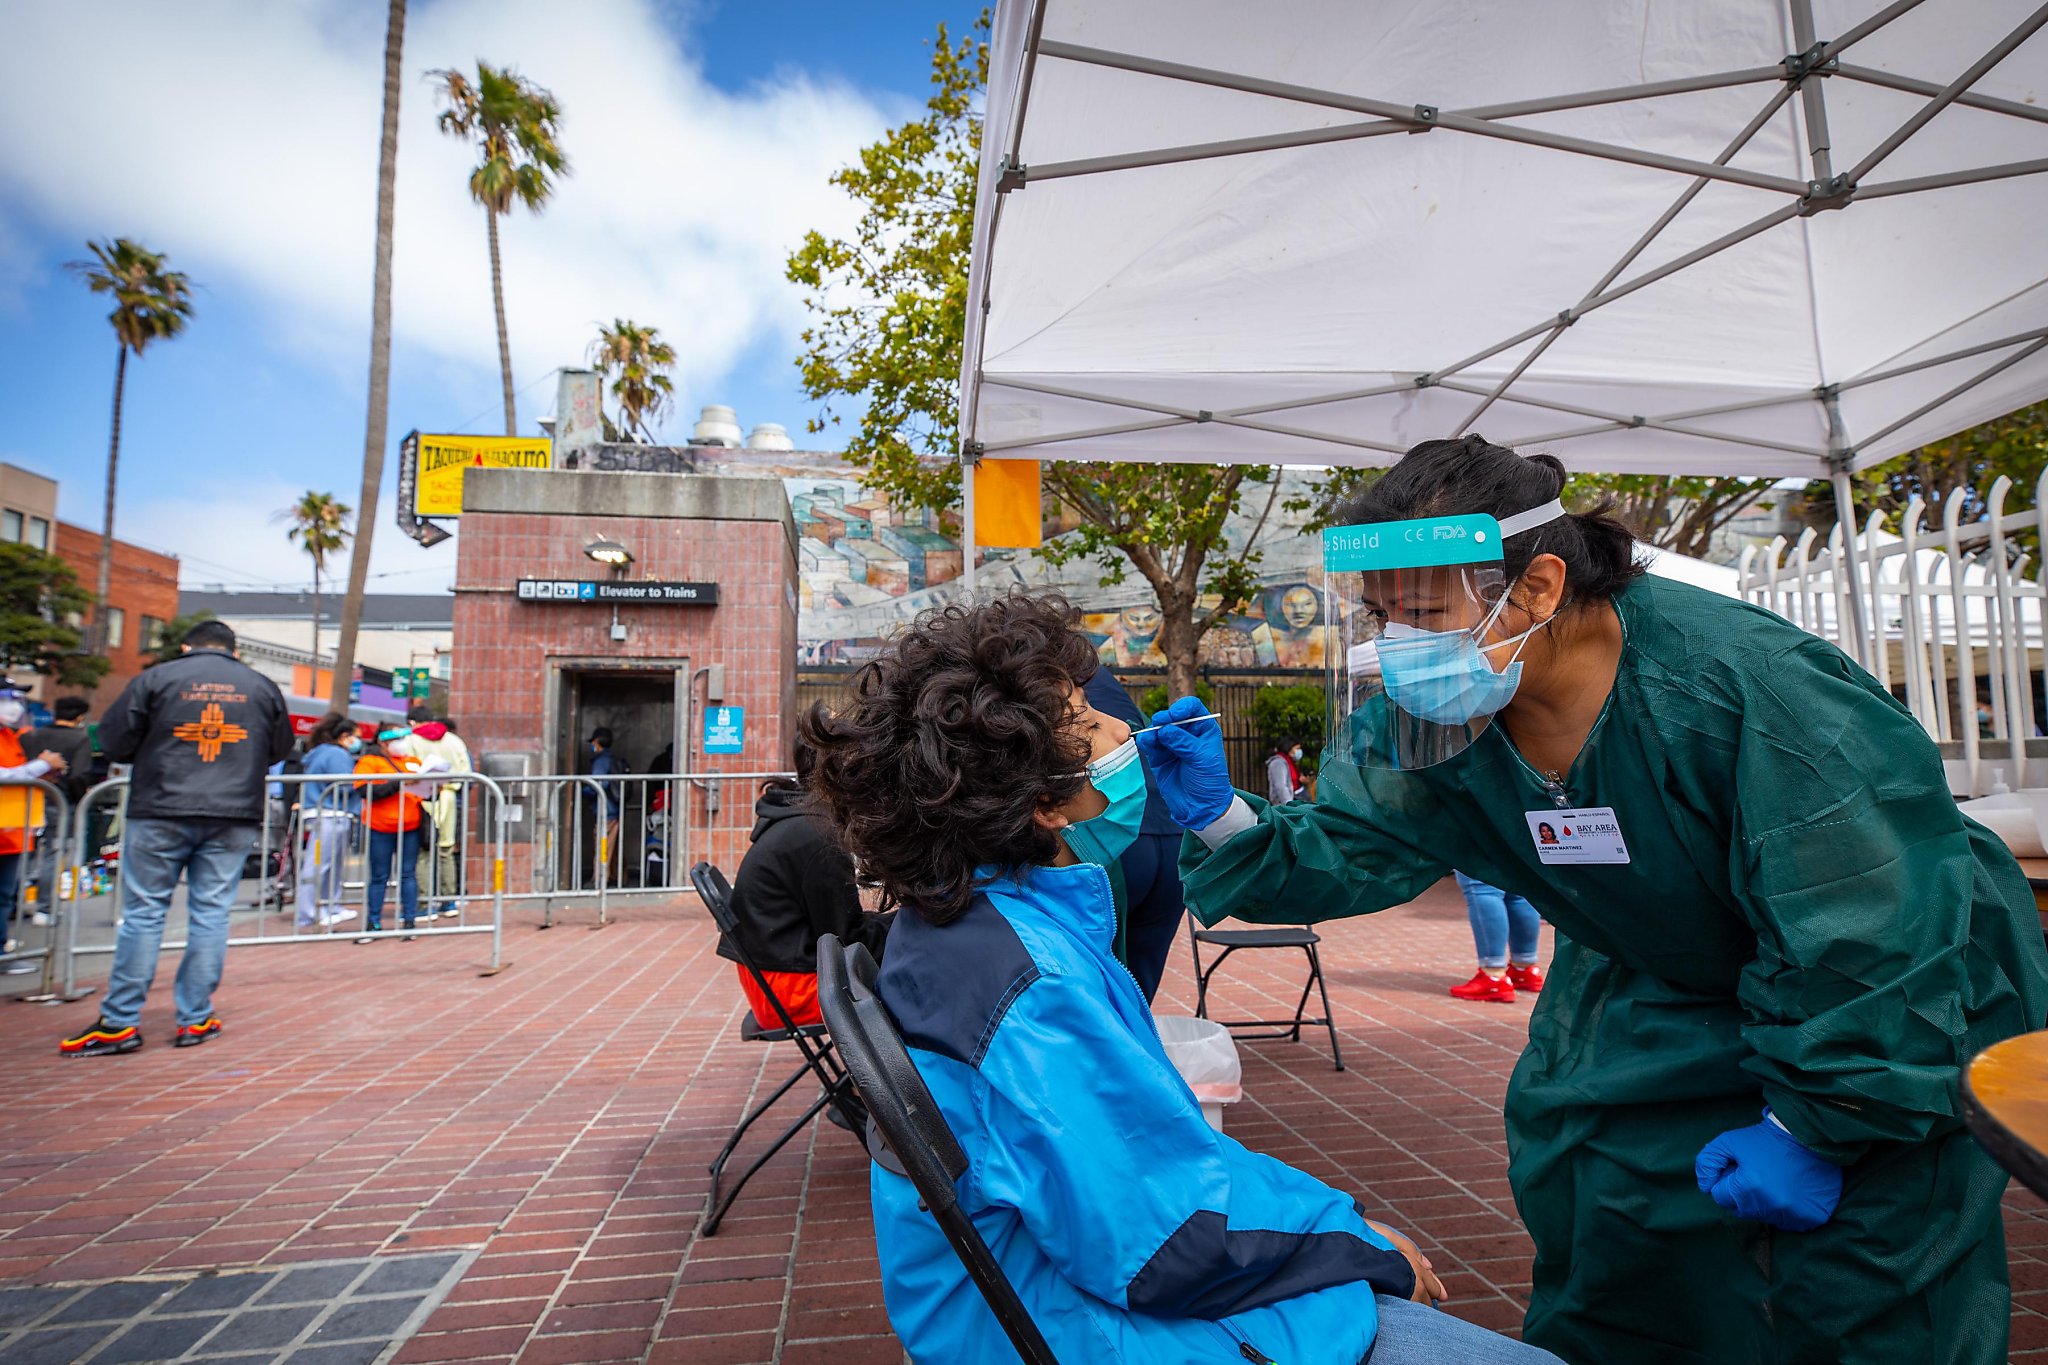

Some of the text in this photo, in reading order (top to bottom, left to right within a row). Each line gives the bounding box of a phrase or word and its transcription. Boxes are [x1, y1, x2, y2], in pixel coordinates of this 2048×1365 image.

[1404, 528, 1424, 543] CE
[1433, 525, 1467, 541] FDA
[1332, 532, 1379, 551] Shield
[600, 585, 697, 598] Elevator to Trains
[192, 682, 236, 693] LATINO
[1595, 823, 1617, 831] AREA
